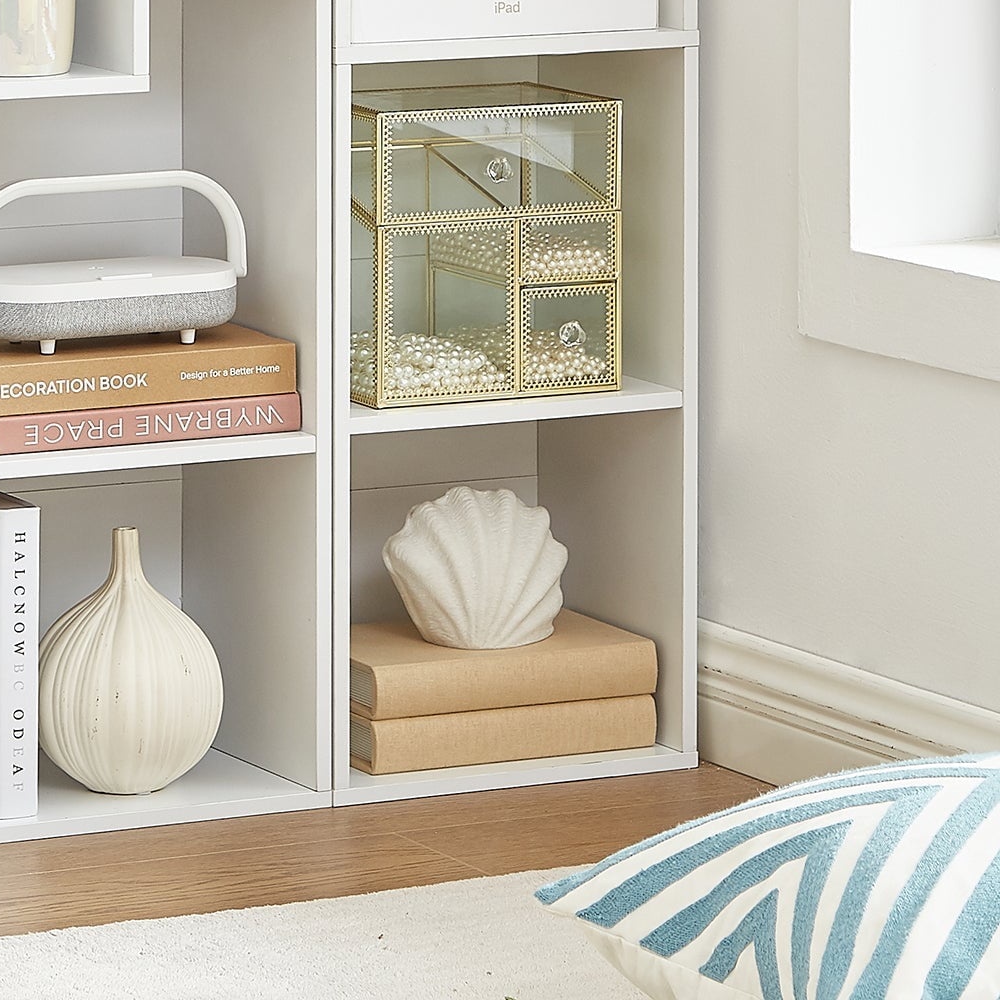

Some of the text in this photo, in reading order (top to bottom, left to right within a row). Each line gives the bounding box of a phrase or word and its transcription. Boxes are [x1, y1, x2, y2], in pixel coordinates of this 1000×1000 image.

[494, 1, 520, 14] iPad
[100, 372, 148, 391] BOOK
[180, 370, 208, 381] Design
[209, 368, 222, 378] for
[229, 366, 254, 376] Better
[255, 364, 280, 374] Home
[24, 404, 284, 446] WYBRANE PRACE
